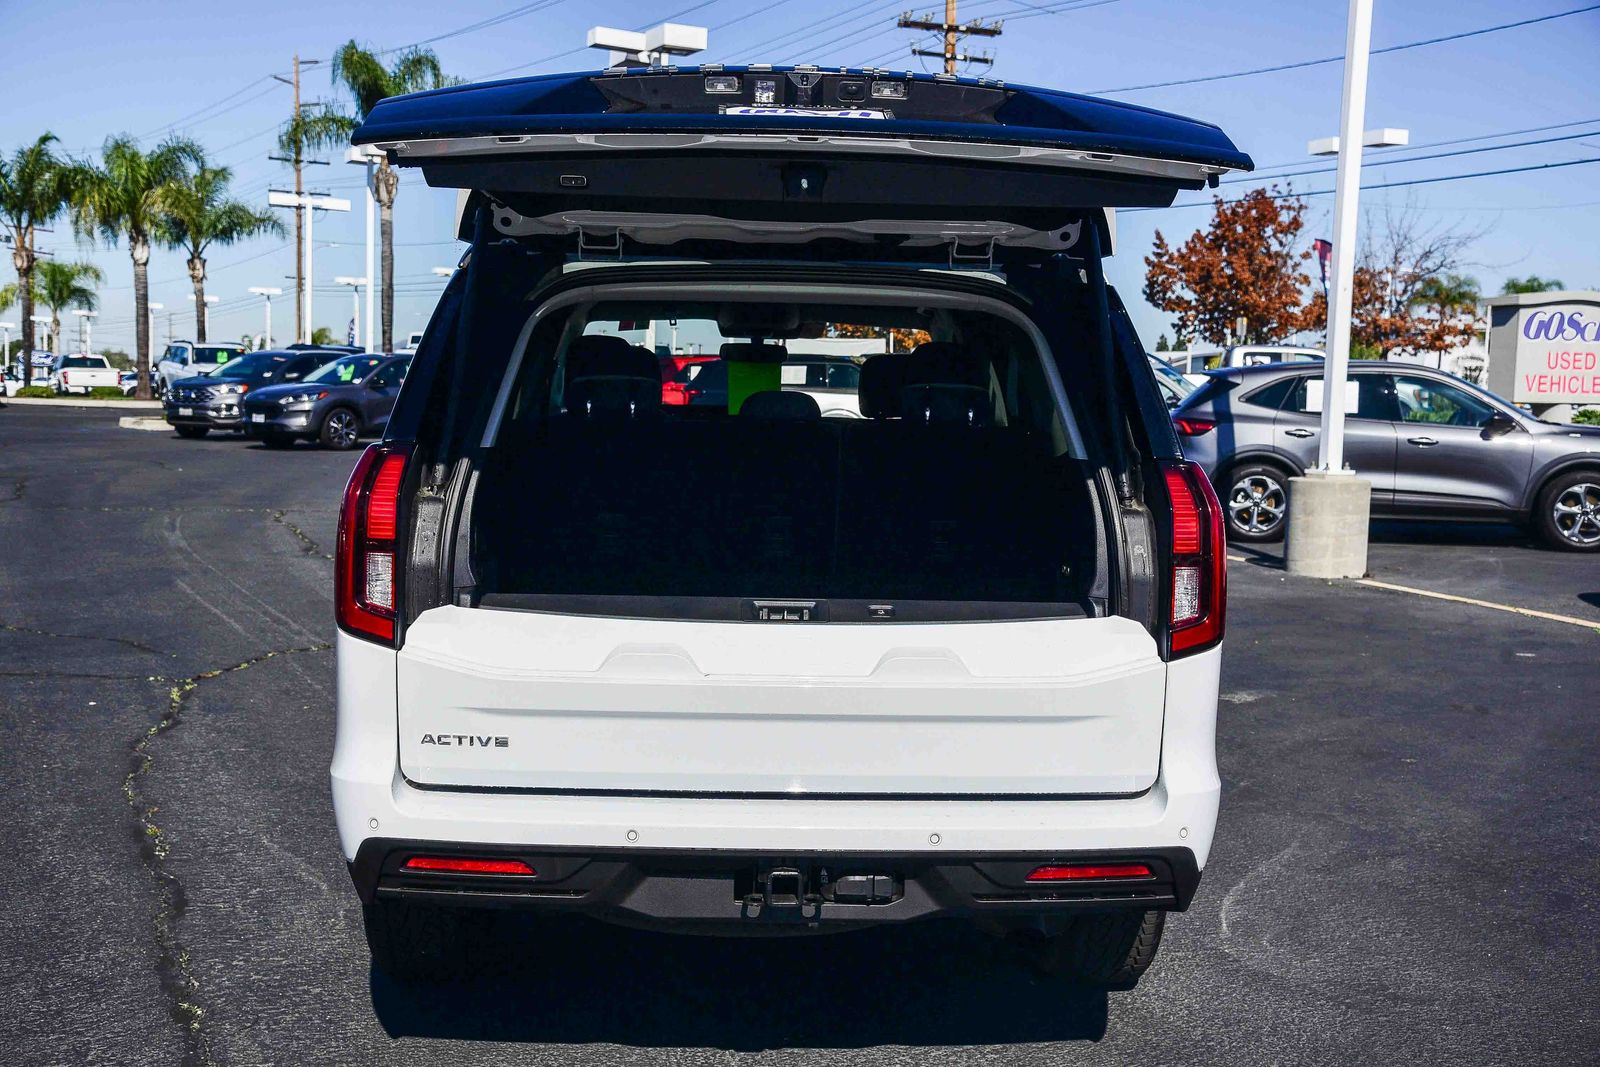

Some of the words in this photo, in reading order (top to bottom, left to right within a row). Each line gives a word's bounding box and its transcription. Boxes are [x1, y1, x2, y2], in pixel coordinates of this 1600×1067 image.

[1523, 310, 1600, 342] GOSC
[1547, 351, 1597, 370] USED
[420, 733, 510, 748] ACTIVE
